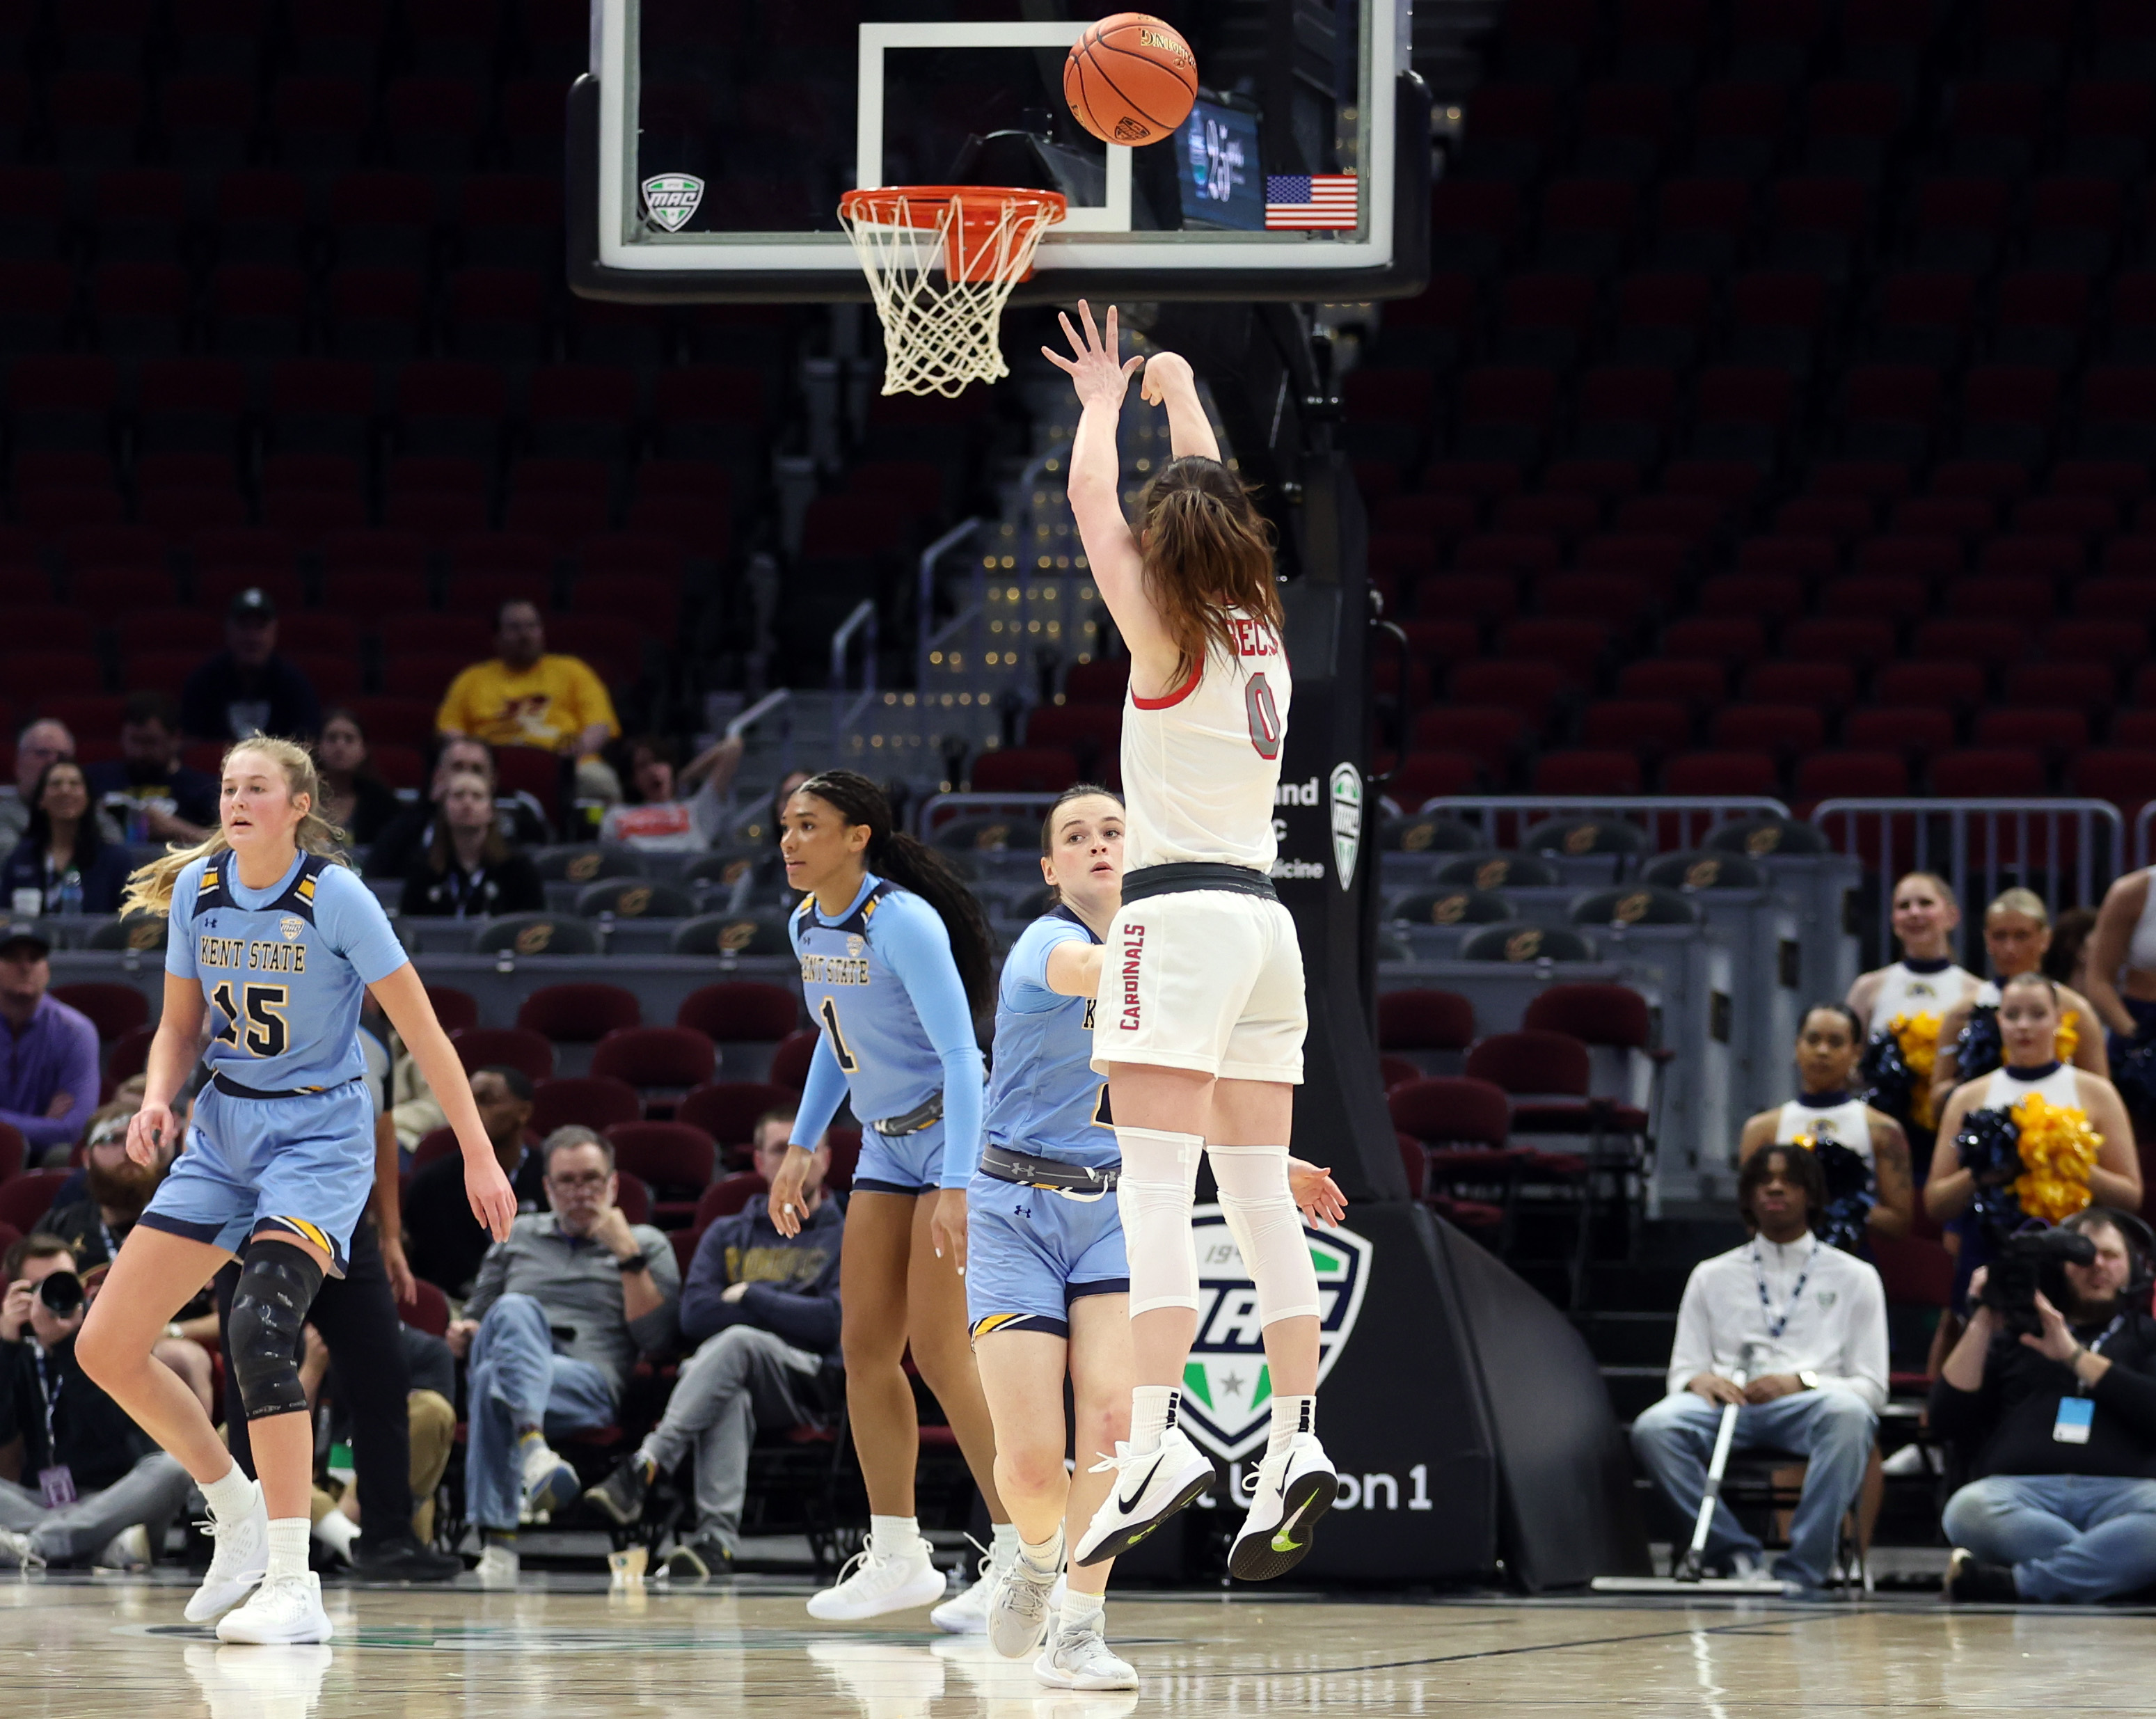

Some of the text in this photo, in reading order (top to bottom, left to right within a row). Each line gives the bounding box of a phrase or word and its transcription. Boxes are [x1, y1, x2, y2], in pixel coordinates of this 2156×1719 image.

[649, 192, 697, 207] MAC
[1245, 672, 1280, 760] 0
[201, 936, 306, 974] KENT STATE
[826, 957, 870, 985] STATE
[1120, 924, 1145, 1031] CARDINALS
[211, 981, 290, 1059] 15
[819, 995, 860, 1073] 1
